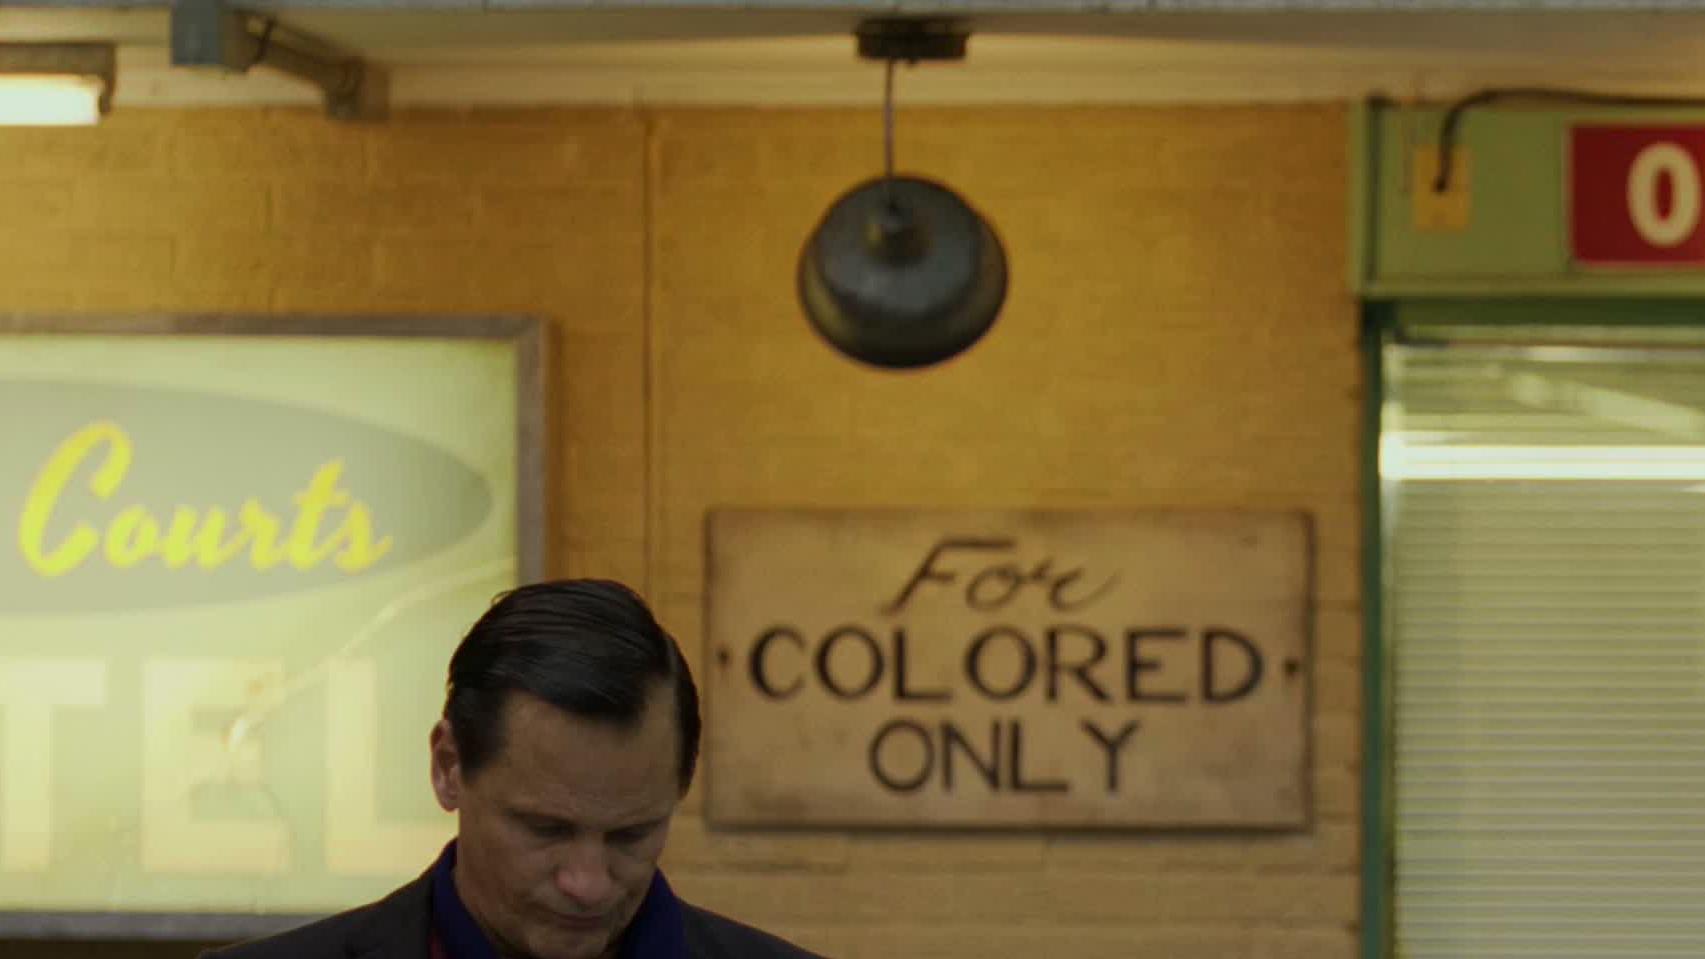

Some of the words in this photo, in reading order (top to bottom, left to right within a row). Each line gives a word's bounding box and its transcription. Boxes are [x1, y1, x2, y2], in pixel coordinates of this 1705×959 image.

[18, 420, 392, 578] Courts
[881, 535, 1122, 616] For
[748, 624, 1266, 703] COLORED
[868, 717, 1141, 794] ONLY
